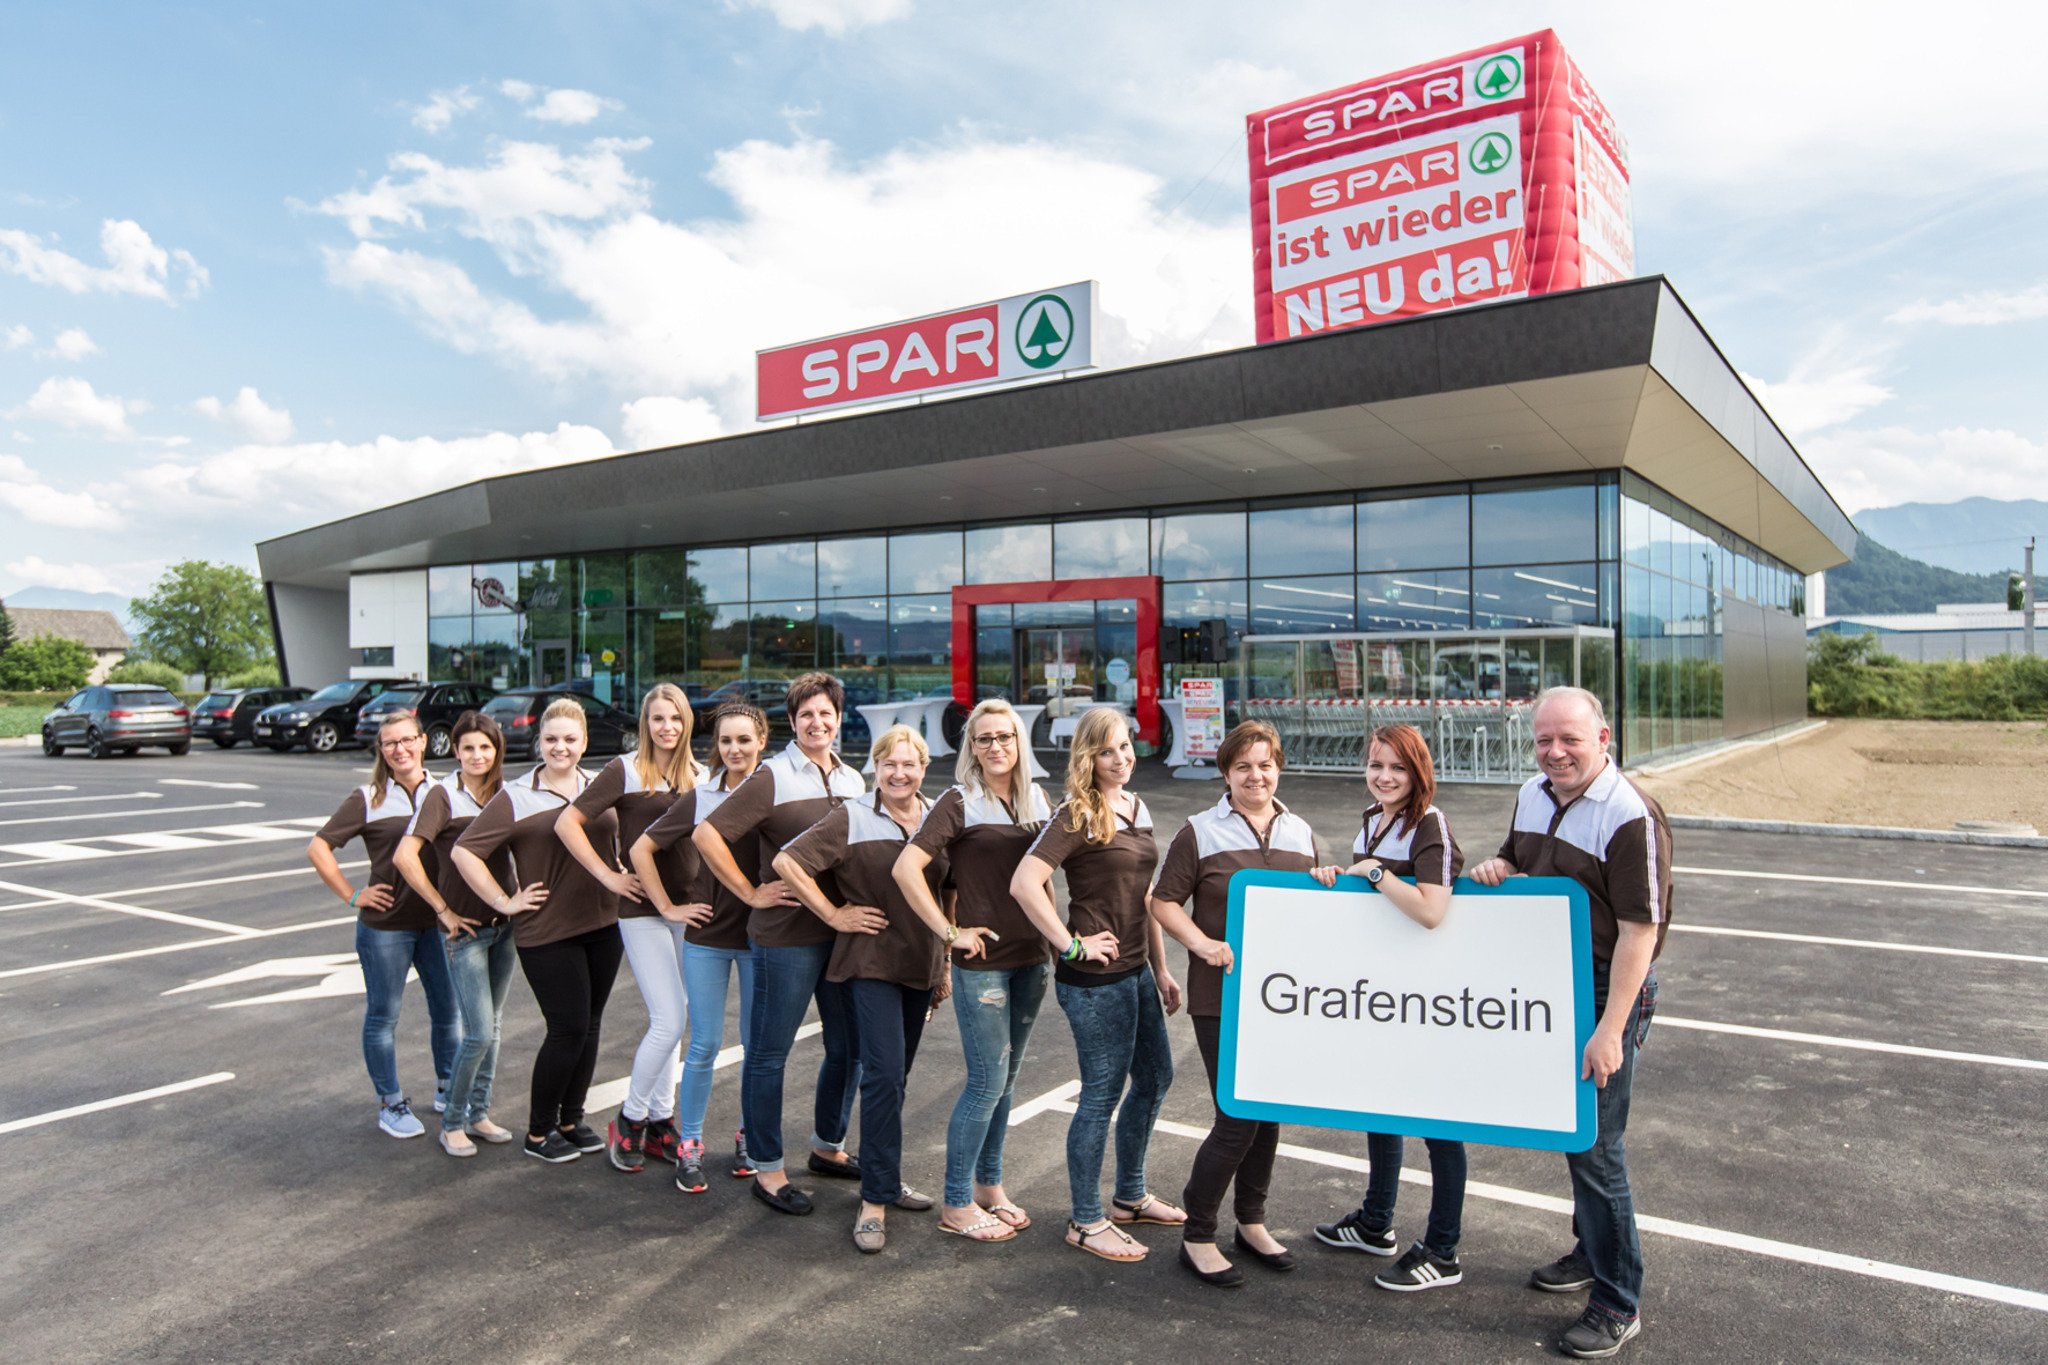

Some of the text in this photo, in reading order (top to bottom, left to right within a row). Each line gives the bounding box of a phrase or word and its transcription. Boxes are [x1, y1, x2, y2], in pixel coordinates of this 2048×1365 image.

[1303, 76, 1460, 141] SPAR
[1310, 150, 1455, 208] SPAR
[1277, 188, 1517, 268] ist wieder
[1285, 238, 1514, 338] NEU da!
[802, 317, 995, 399] SPAR
[1188, 681, 1213, 690] SPAR
[1260, 972, 1553, 1034] Grafenstein
